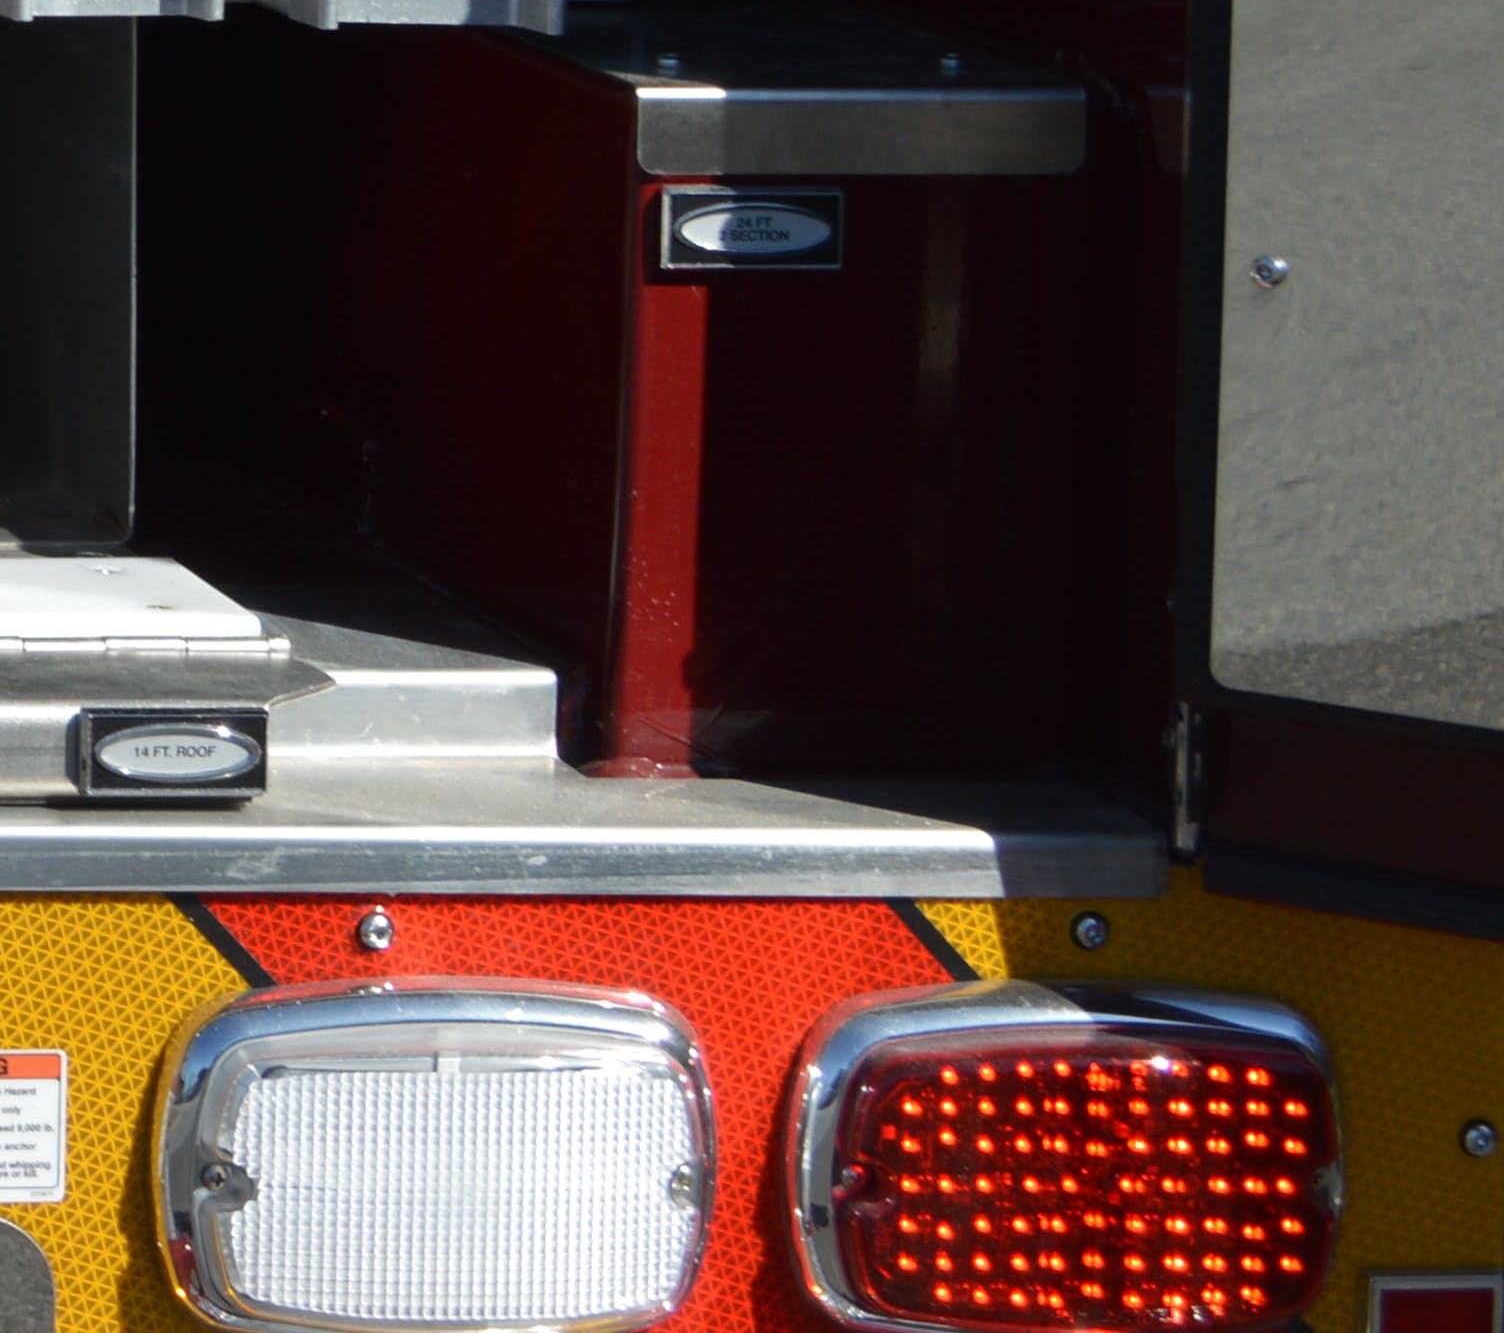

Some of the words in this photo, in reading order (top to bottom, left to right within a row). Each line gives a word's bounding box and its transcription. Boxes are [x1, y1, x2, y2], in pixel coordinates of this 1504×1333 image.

[737, 217, 752, 228] 24
[756, 217, 773, 228] FT
[729, 230, 790, 241] SECTION
[133, 745, 148, 758] 14
[150, 745, 172, 758] FT.
[175, 745, 216, 758] ROOF
[2, 1106, 21, 1116] only
